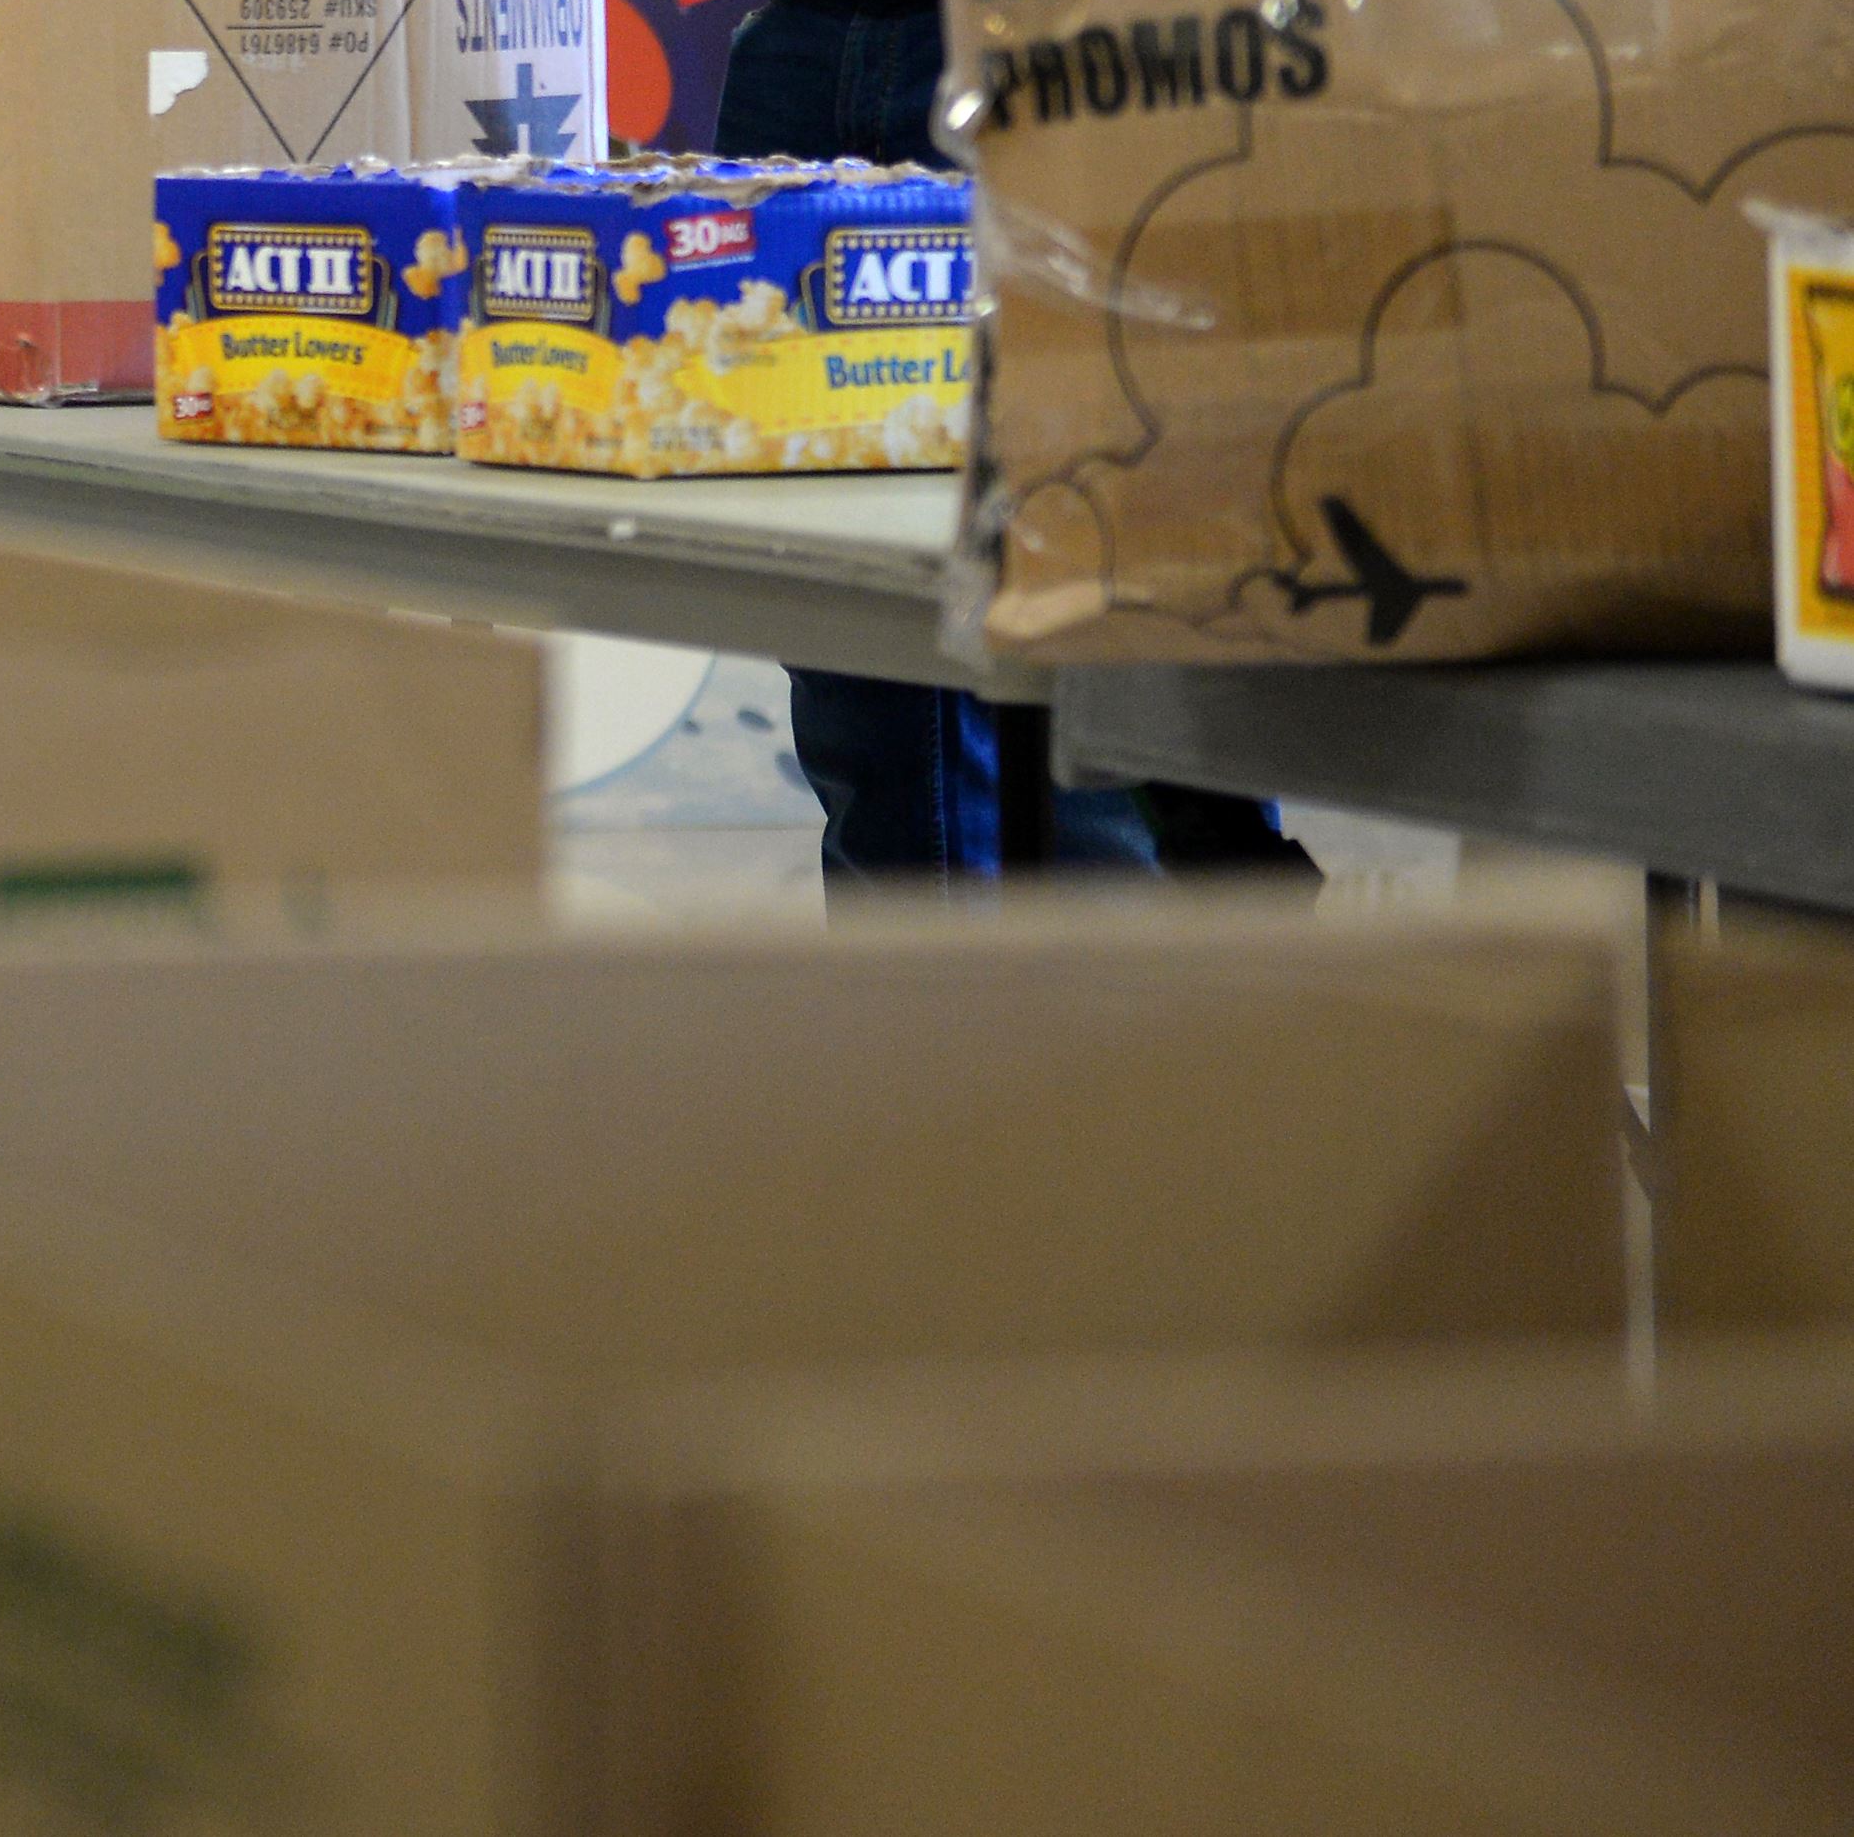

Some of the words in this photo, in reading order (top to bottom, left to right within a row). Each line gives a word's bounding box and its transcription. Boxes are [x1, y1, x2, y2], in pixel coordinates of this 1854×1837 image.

[241, 31, 321, 56] 6486761
[329, 30, 369, 54] PO#
[669, 218, 720, 258] 30
[224, 245, 302, 294] ACT
[307, 248, 354, 295] II
[494, 247, 547, 299] ACT
[549, 250, 583, 301] II
[847, 250, 957, 304] ACT
[220, 332, 290, 361] Butter
[294, 331, 366, 366] Lovers
[492, 339, 537, 369] Butter
[538, 337, 589, 376] Lovers
[824, 353, 937, 391] Butter
